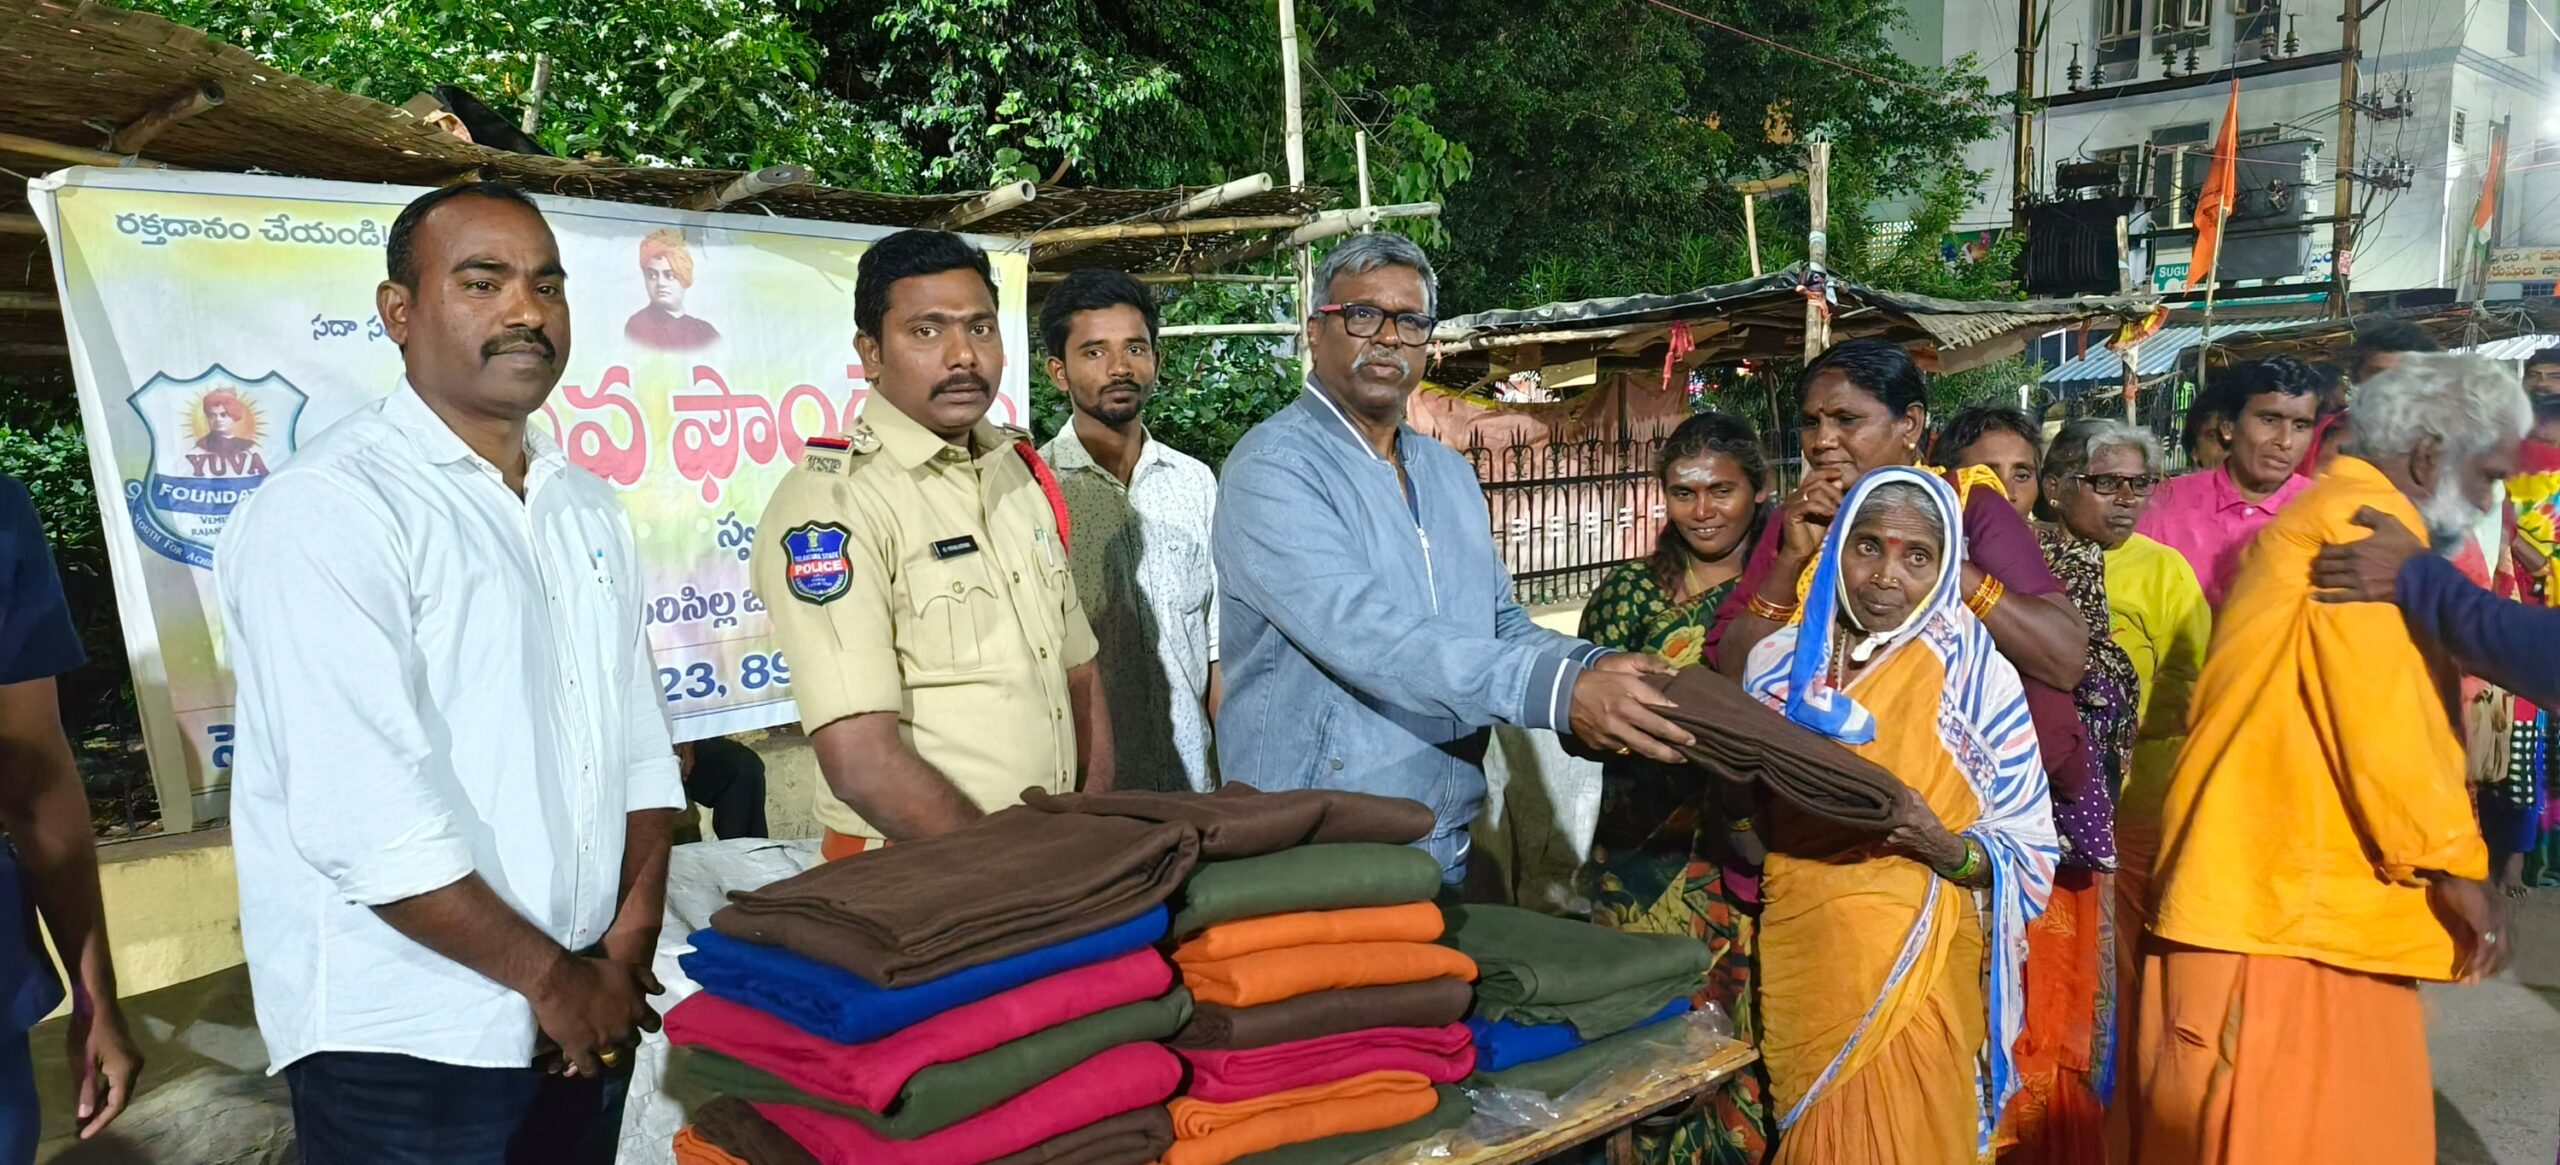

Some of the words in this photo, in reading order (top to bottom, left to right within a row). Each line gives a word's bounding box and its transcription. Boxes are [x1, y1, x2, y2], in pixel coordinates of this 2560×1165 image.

[115, 212, 251, 245] రక్తదానం
[258, 213, 387, 248] చేయండి!
[2159, 266, 2189, 278] SUGU
[311, 313, 358, 341] సదా
[541, 365, 647, 485] వ
[185, 453, 270, 477] YUVA
[795, 559, 843, 576] POLICE
[646, 586, 738, 628] రిసిల్ల
[656, 662, 727, 701] 23,
